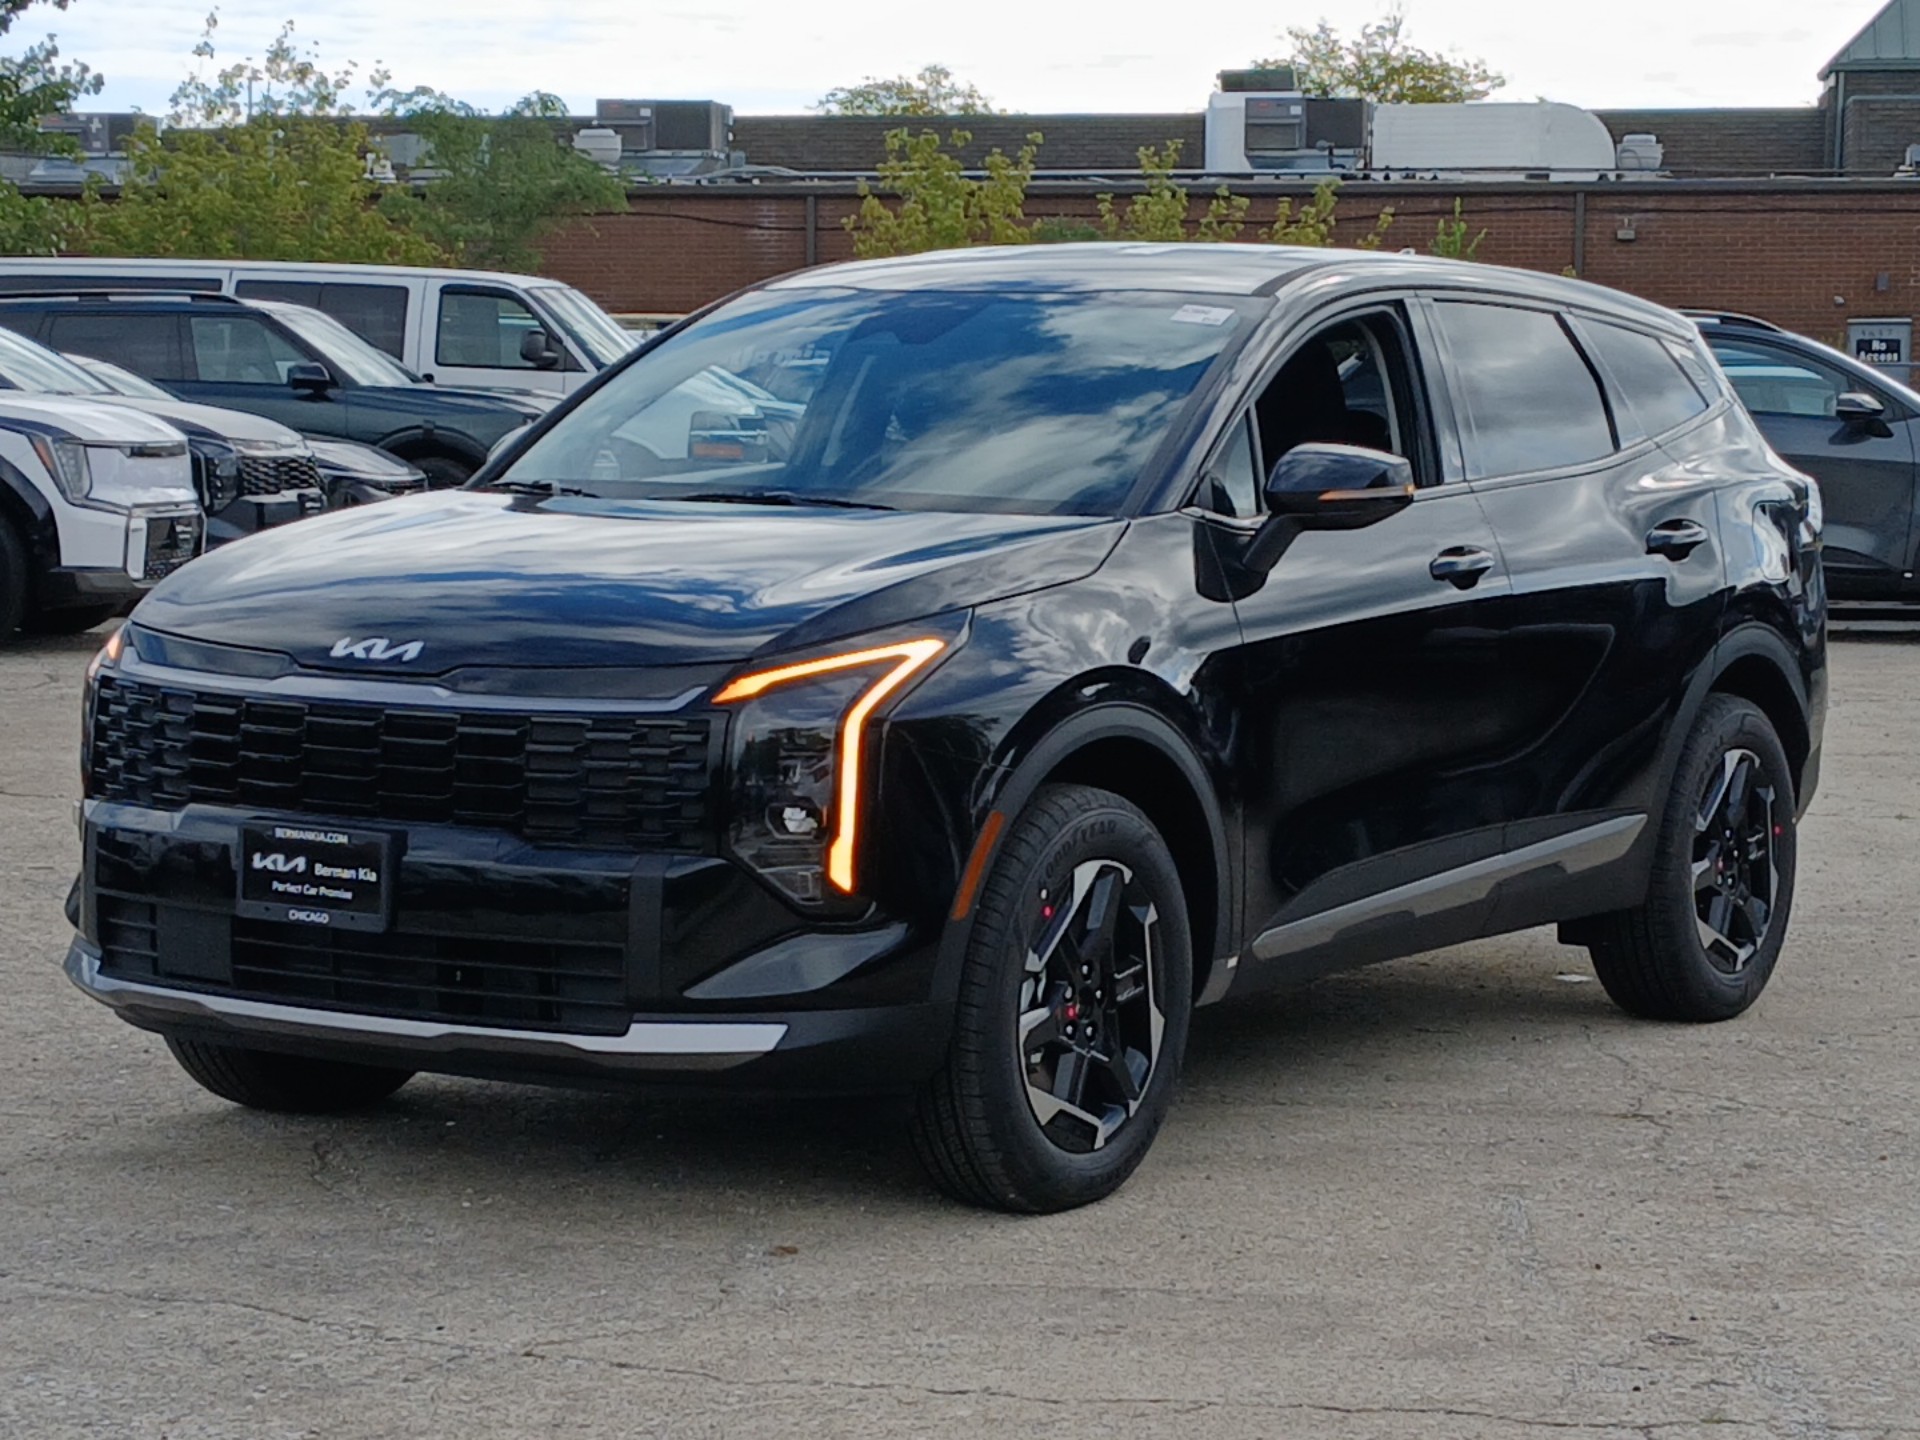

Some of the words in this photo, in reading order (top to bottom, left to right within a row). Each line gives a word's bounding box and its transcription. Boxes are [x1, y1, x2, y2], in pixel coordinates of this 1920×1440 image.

[1871, 340, 1887, 351] No
[329, 636, 425, 662] KIA
[252, 852, 306, 873] KIA
[314, 863, 356, 880] Berman
[358, 866, 377, 882] Kia
[288, 909, 329, 924] CHICAGO
